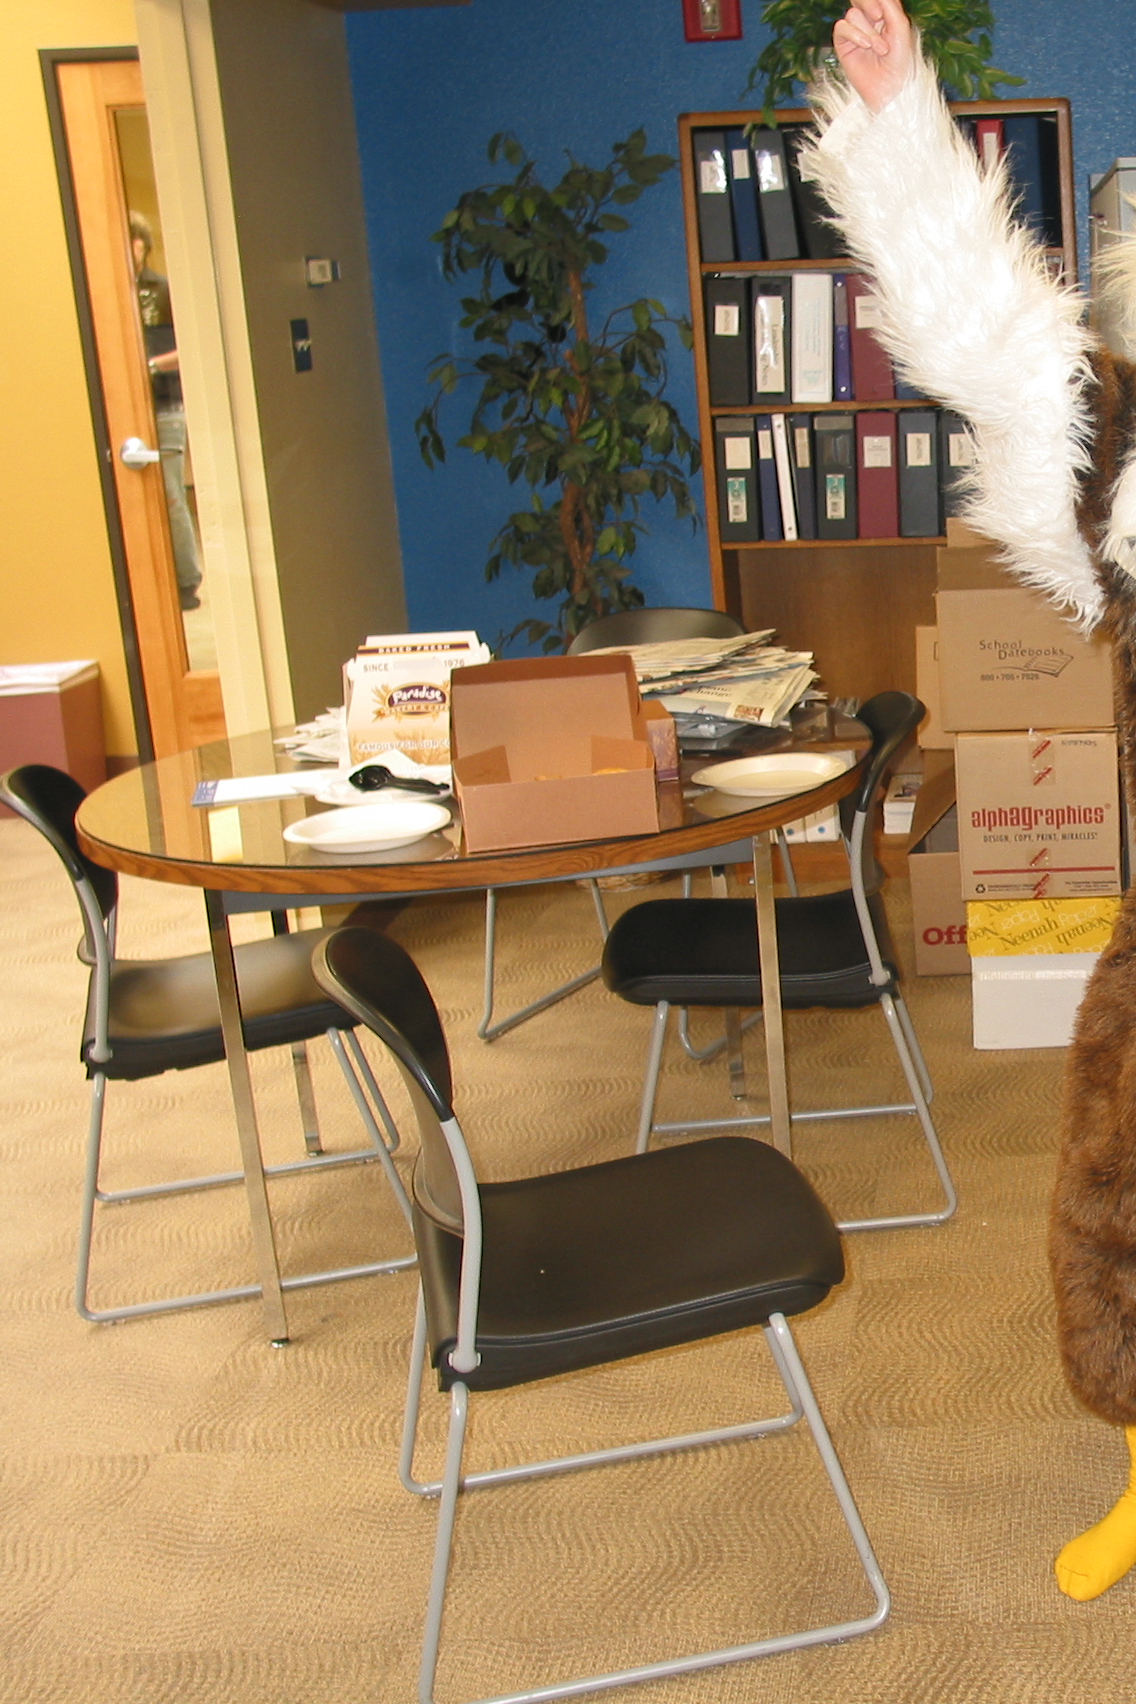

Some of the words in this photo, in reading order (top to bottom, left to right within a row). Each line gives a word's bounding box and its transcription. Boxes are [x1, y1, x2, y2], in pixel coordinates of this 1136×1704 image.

[979, 640, 1022, 650] School
[998, 647, 1065, 660] Datebooks
[363, 663, 389, 673] SINCE
[392, 685, 443, 706] Paradise
[358, 742, 395, 751] FAMOUS
[1000, 917, 1059, 950] Neenah
